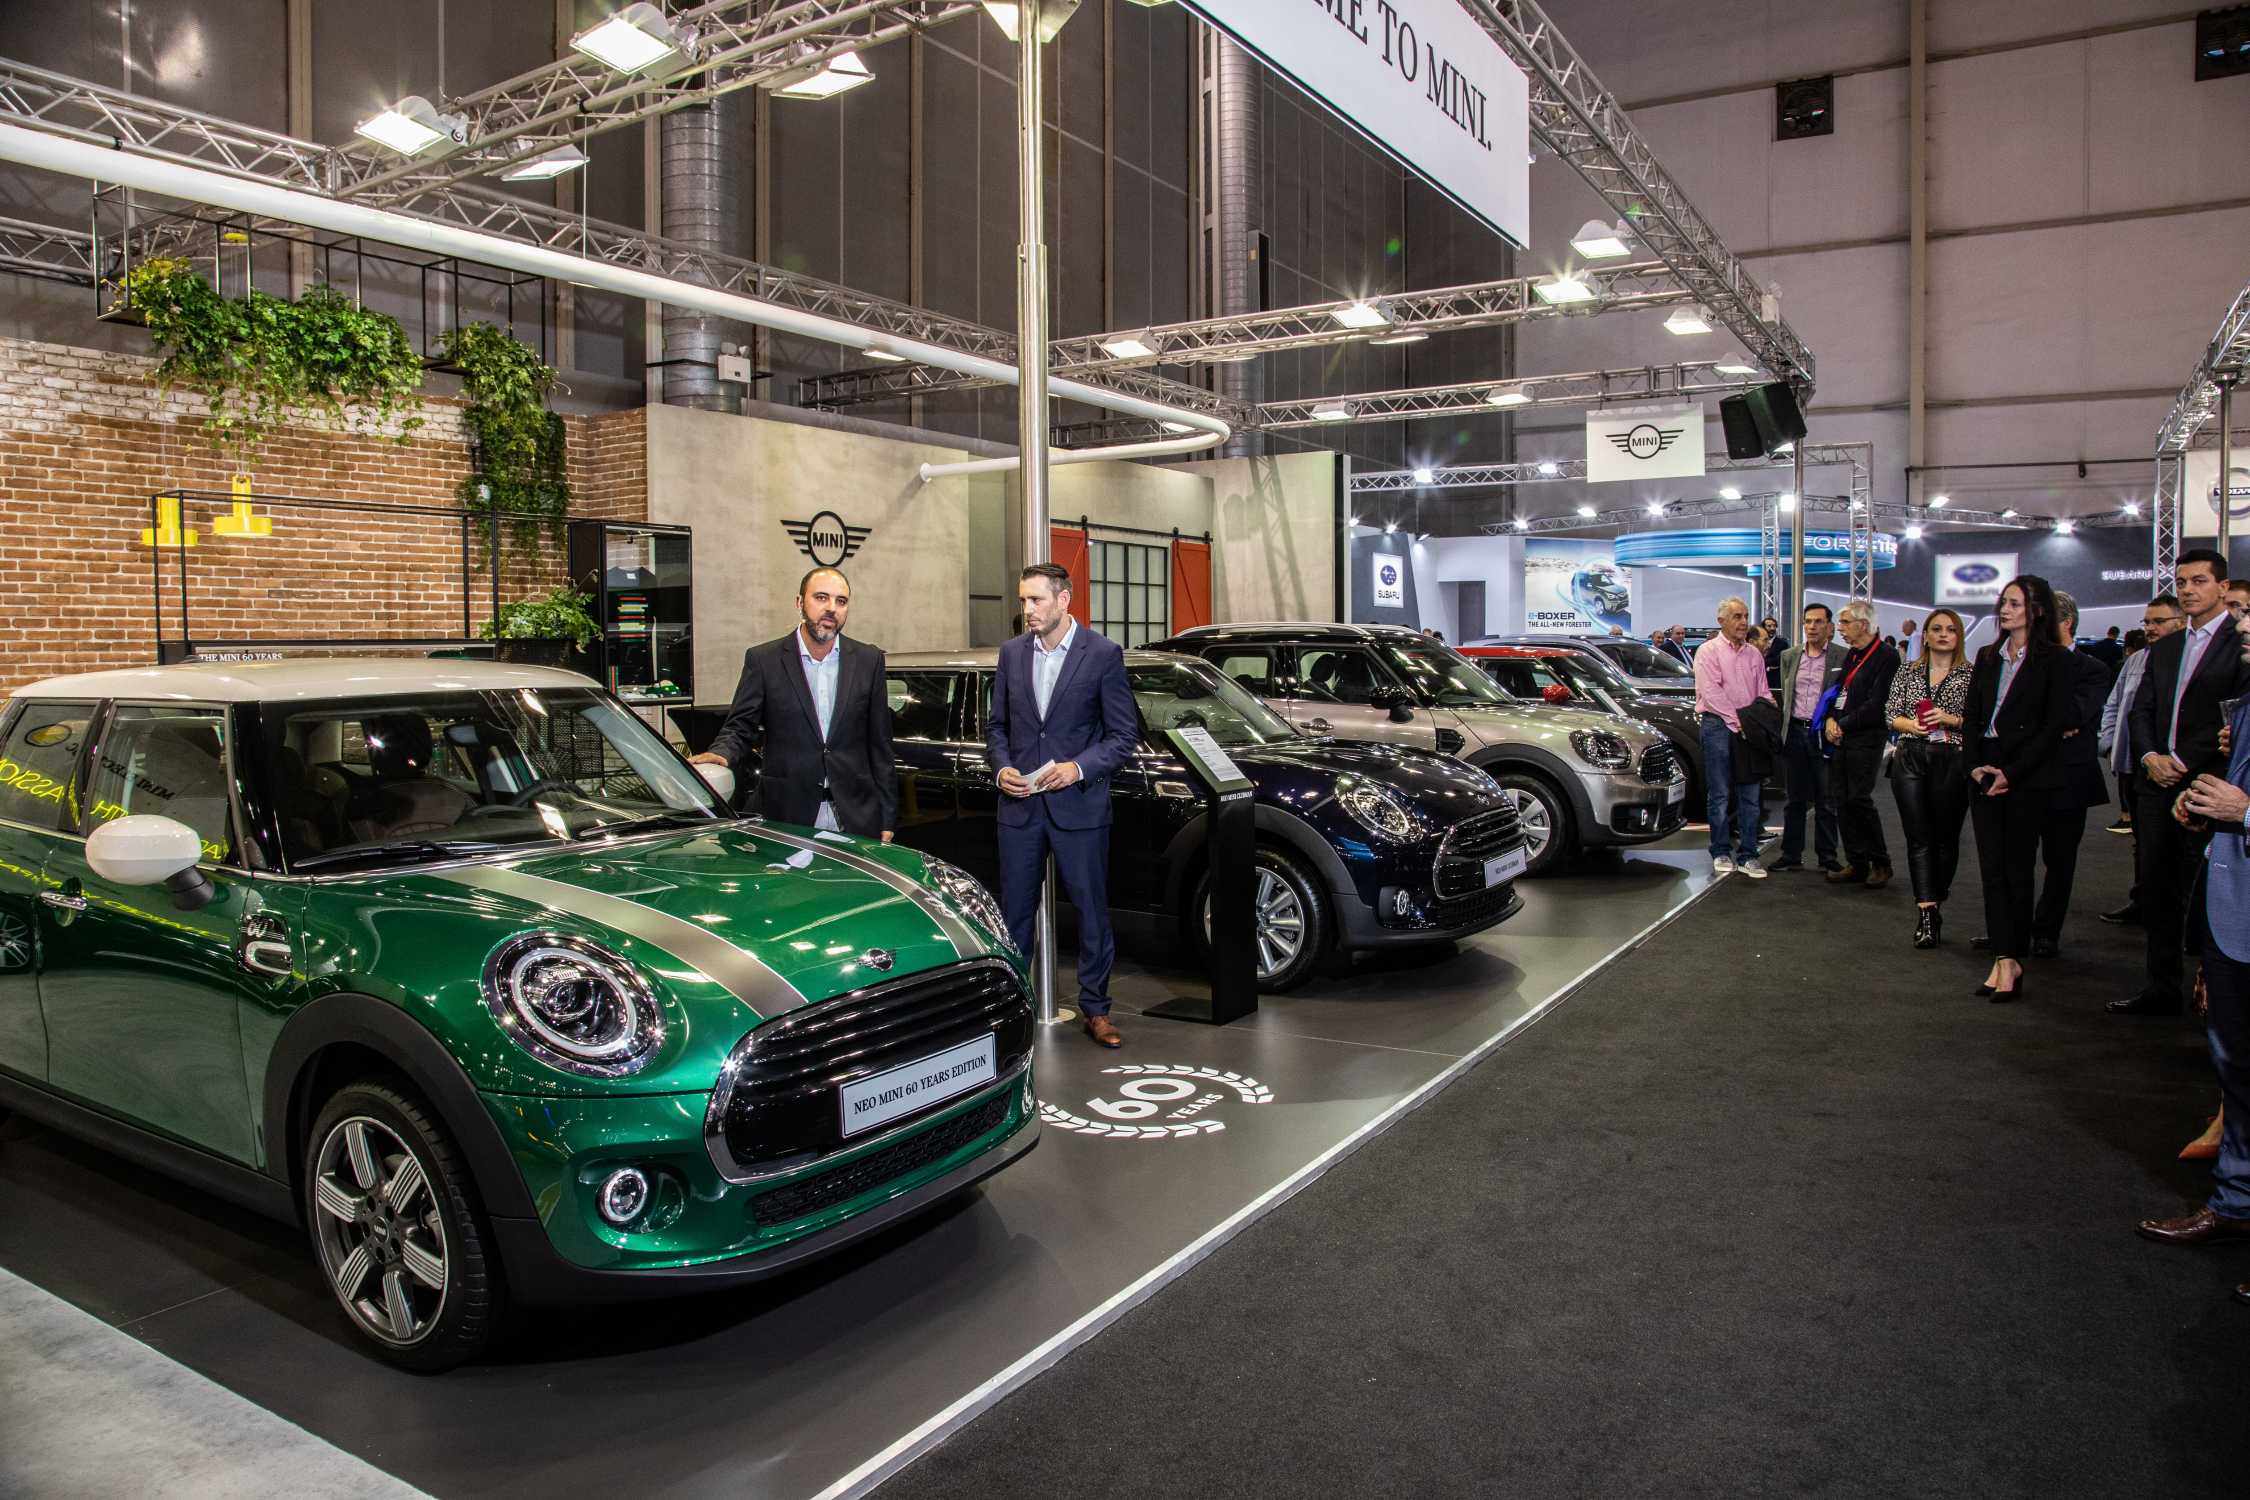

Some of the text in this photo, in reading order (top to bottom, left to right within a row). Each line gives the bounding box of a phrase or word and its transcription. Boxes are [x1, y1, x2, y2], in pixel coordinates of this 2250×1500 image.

[1378, 0, 1418, 82] TO
[1426, 42, 1492, 152] MINI.
[1632, 437, 1658, 447] MINI
[812, 531, 844, 549] MINI
[200, 652, 282, 662] THE MINI 60 YEARS
[853, 1054, 987, 1115] NEO MINI 60 YEARS EDITION
[1086, 1078, 1197, 1119] 60
[1165, 1093, 1225, 1119] YEARS
